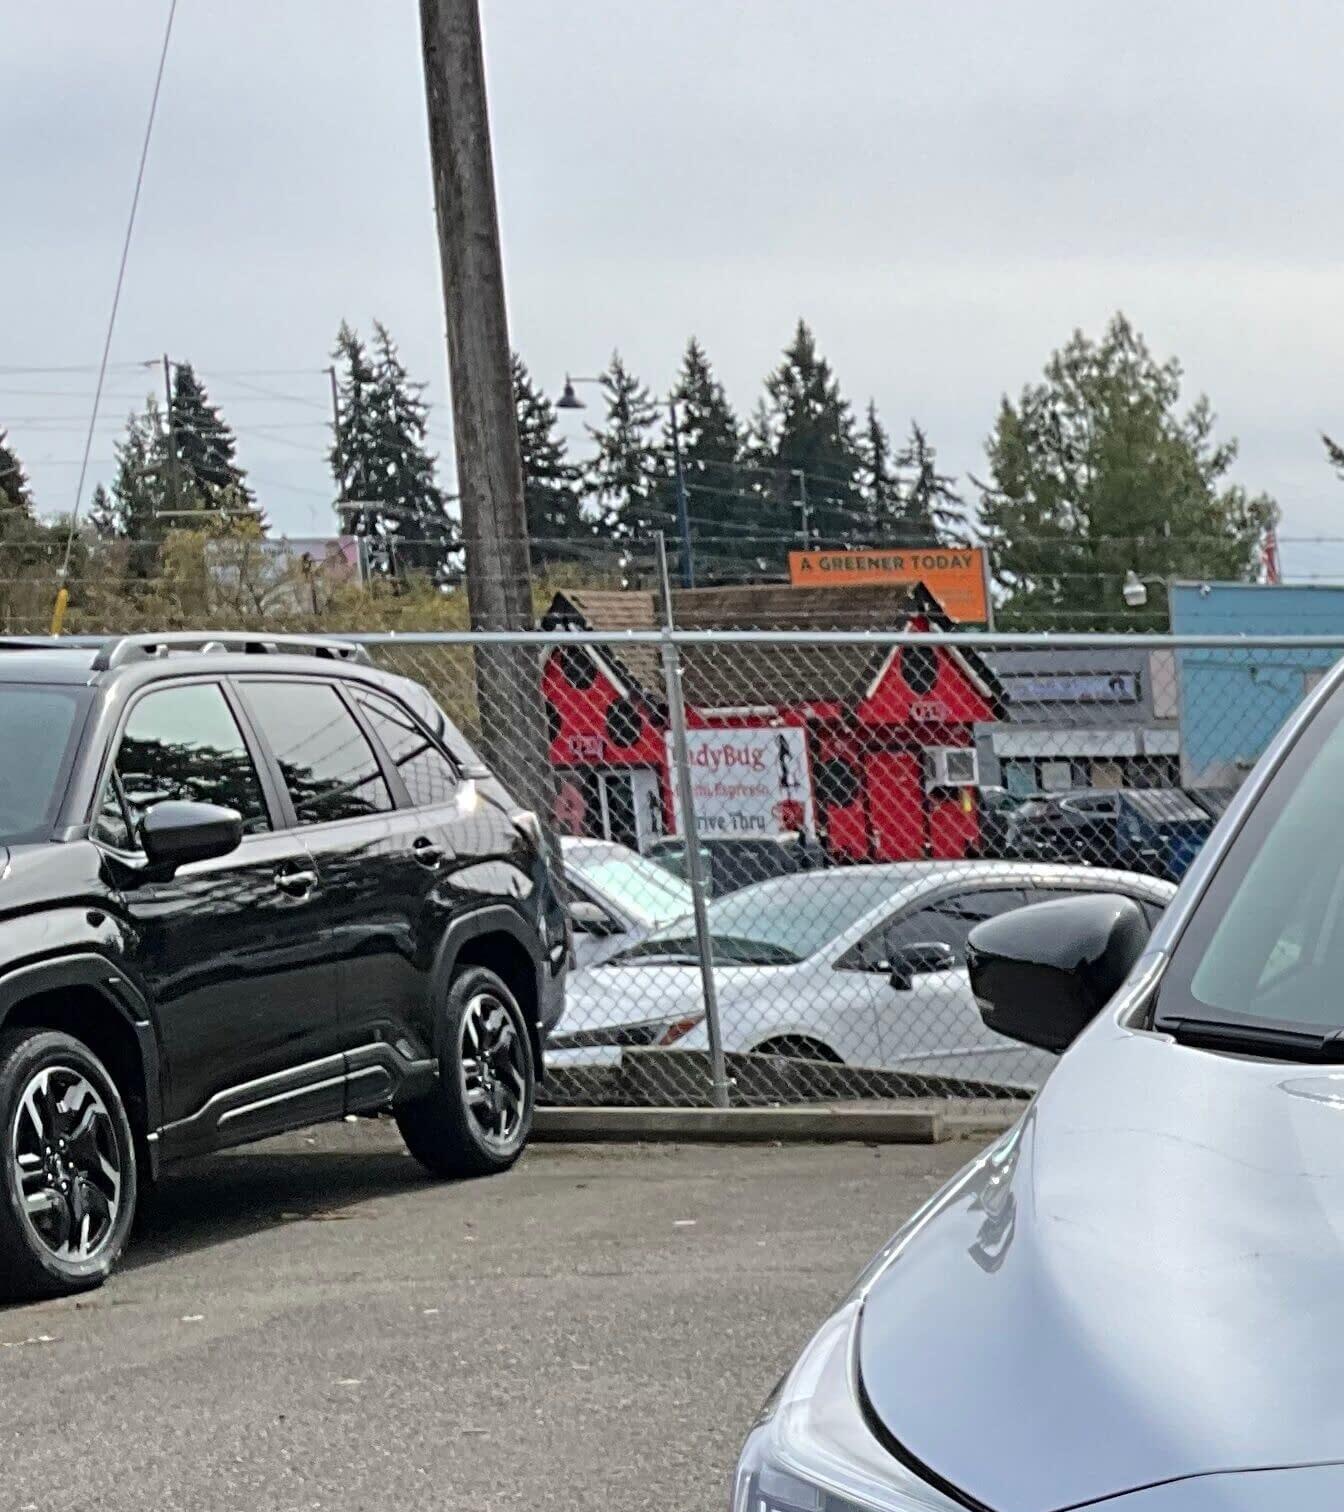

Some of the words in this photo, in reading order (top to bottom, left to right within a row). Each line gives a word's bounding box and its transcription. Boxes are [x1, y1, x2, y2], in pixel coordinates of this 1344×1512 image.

[801, 557, 812, 571] A
[819, 556, 904, 571] GREENER
[911, 555, 972, 569] TODAY
[696, 814, 726, 830] rive
